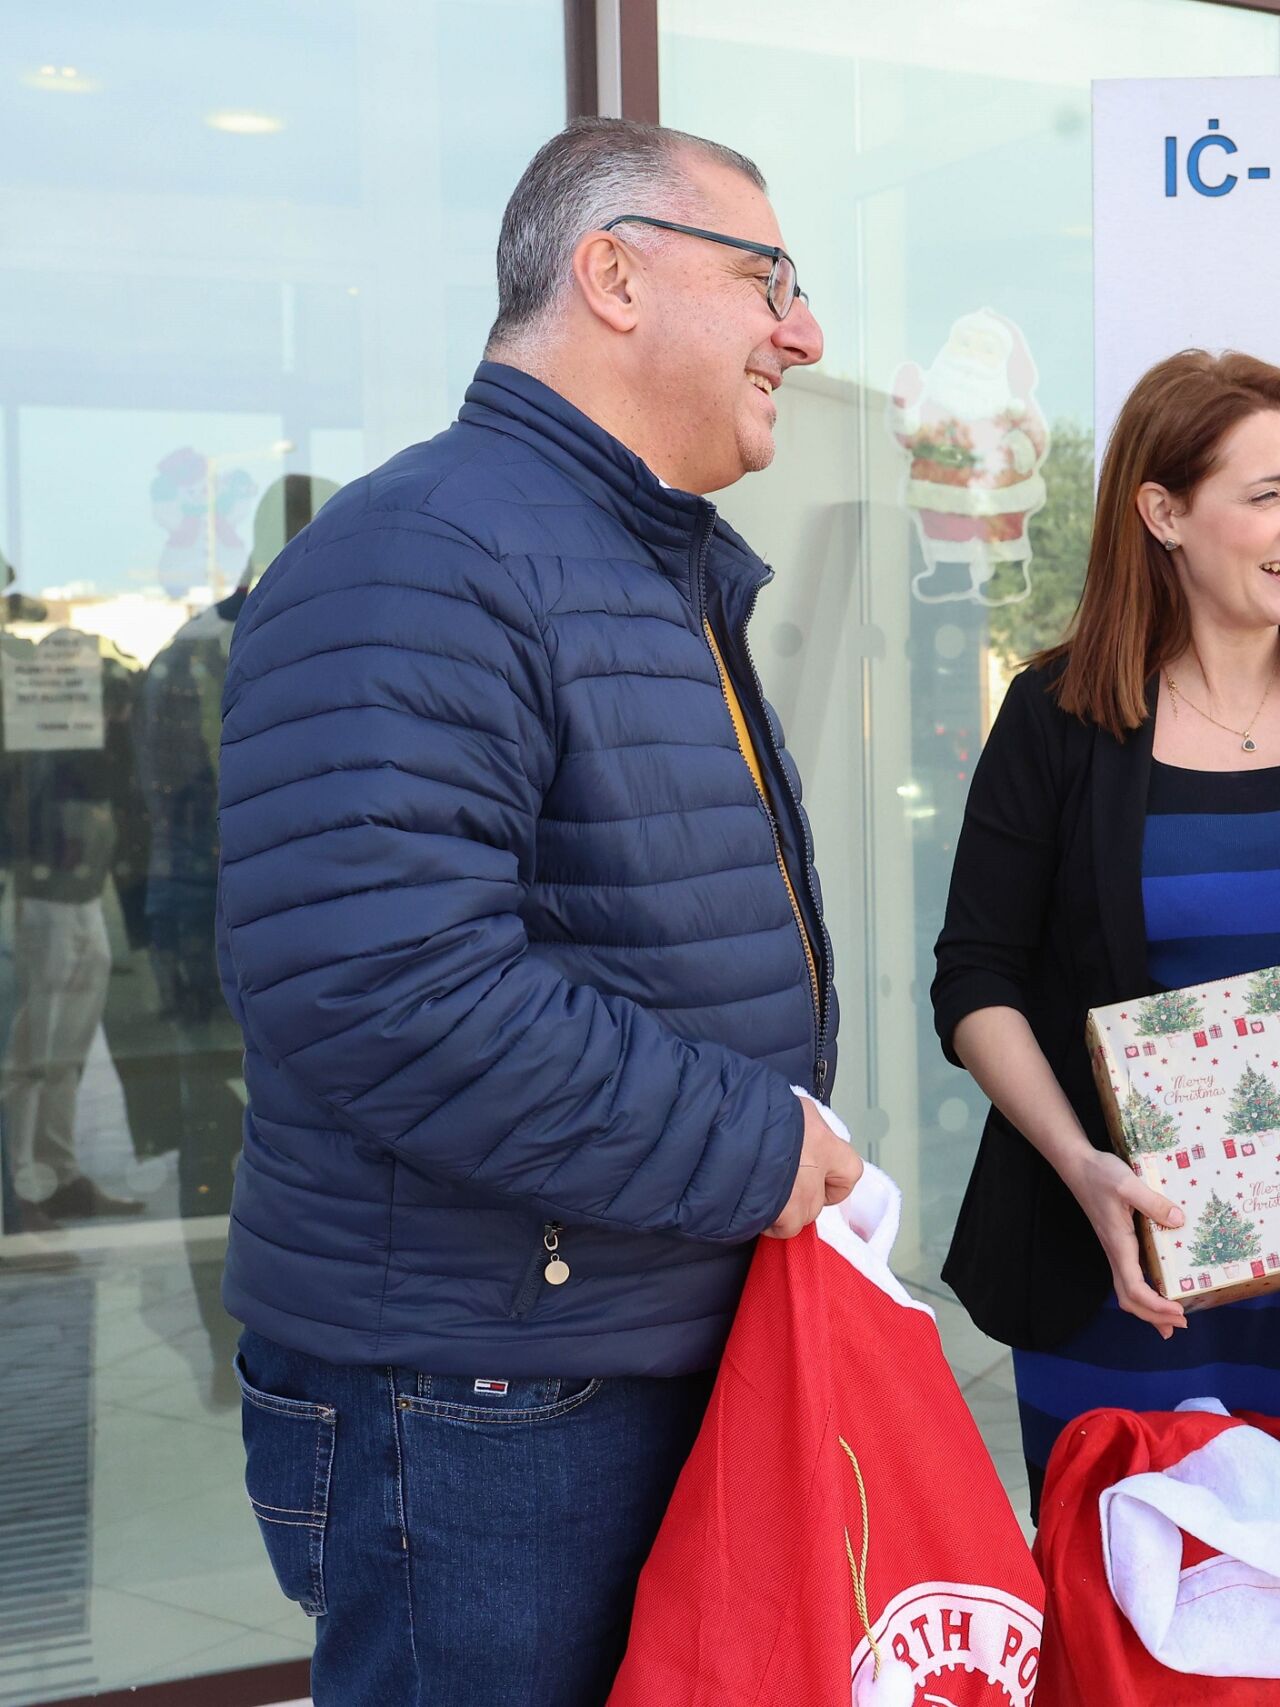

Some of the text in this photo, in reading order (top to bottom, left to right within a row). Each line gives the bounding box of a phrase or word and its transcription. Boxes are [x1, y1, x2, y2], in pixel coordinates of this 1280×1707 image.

[1165, 118, 1271, 198] IĊ-
[1171, 1074, 1214, 1089] Merry
[1164, 1086, 1226, 1106] Christmas
